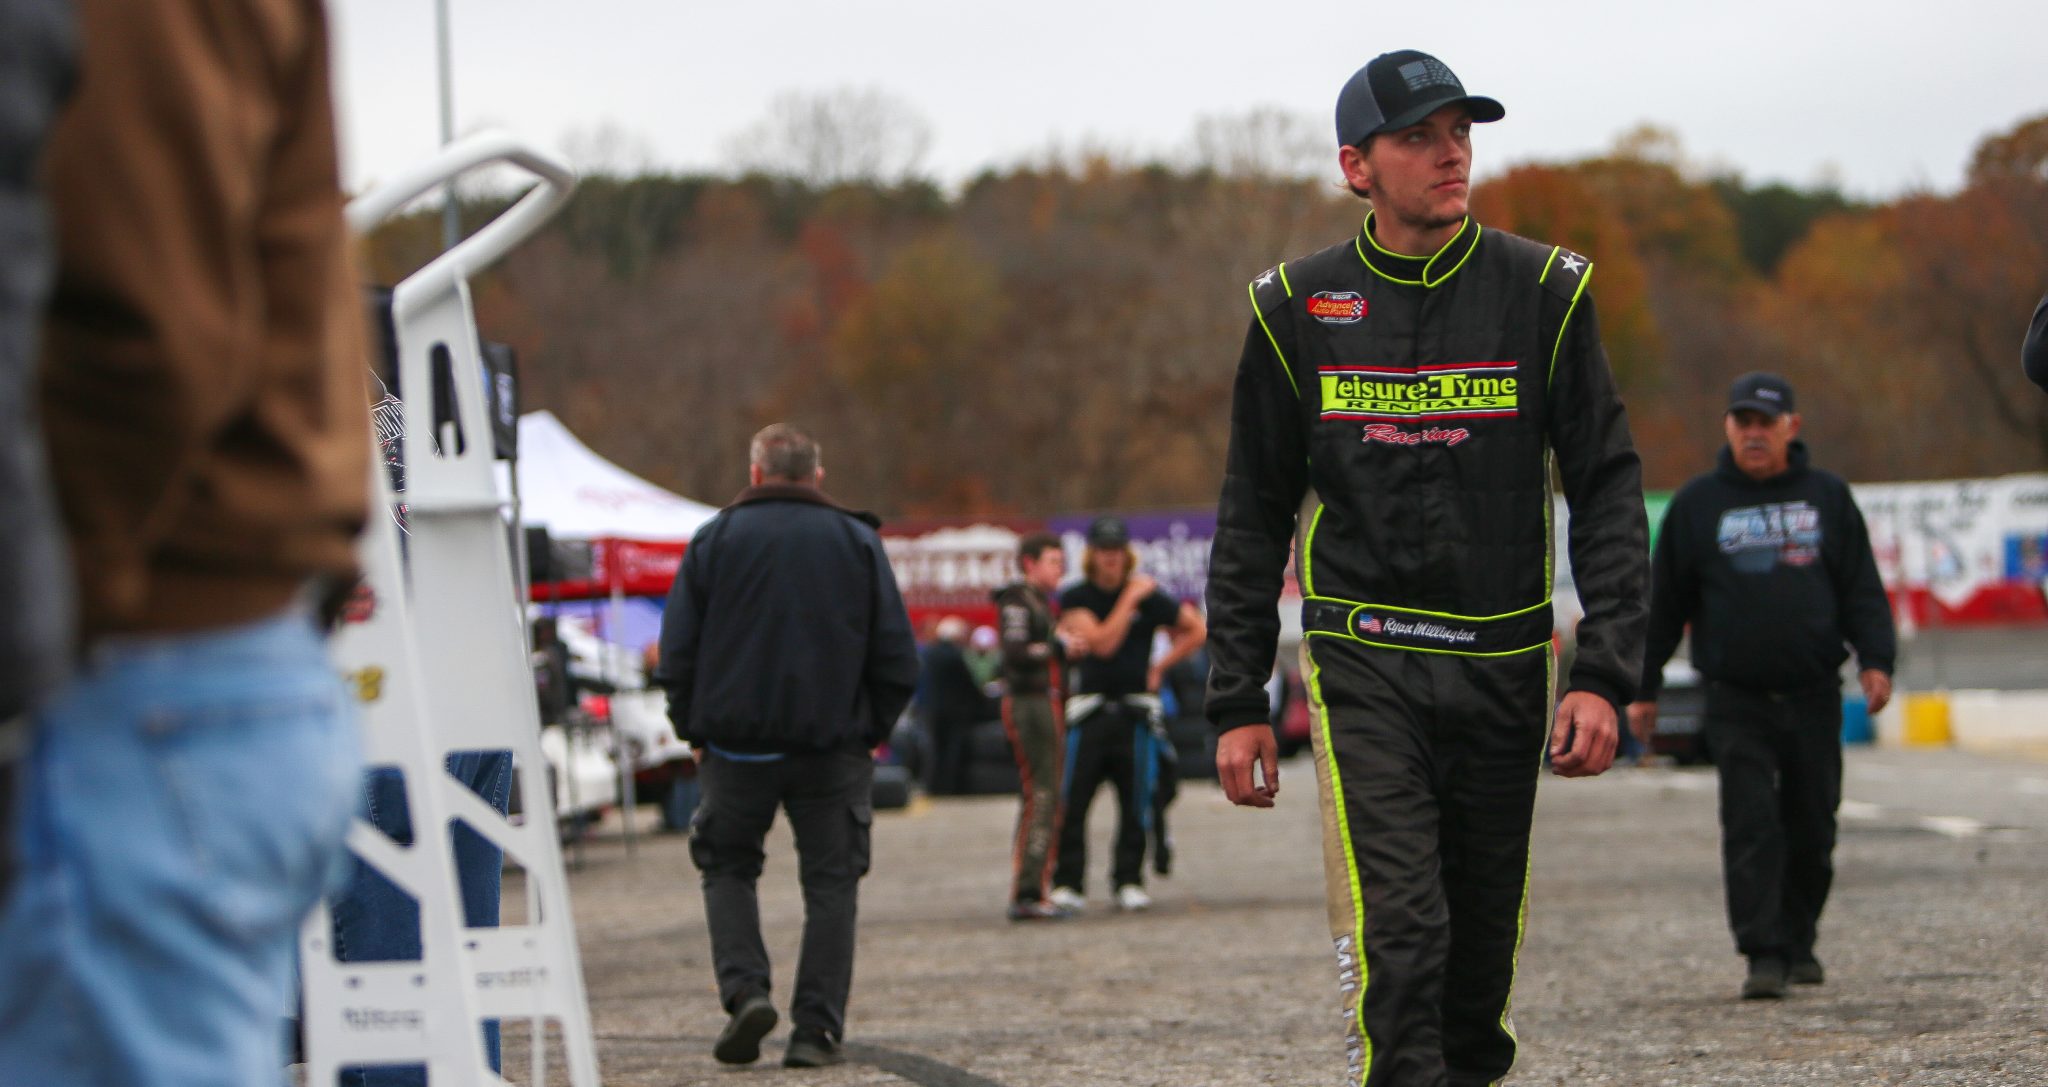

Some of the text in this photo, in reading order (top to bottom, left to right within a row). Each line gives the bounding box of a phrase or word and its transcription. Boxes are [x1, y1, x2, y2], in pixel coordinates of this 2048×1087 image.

[1312, 307, 1331, 315] Auto
[1316, 300, 1351, 309] Advance
[1320, 374, 1517, 409] Leisure-Tyme
[1346, 397, 1498, 412] RENTALS
[1362, 423, 1470, 446] Racing
[1383, 617, 1477, 643] Ryan Millington
